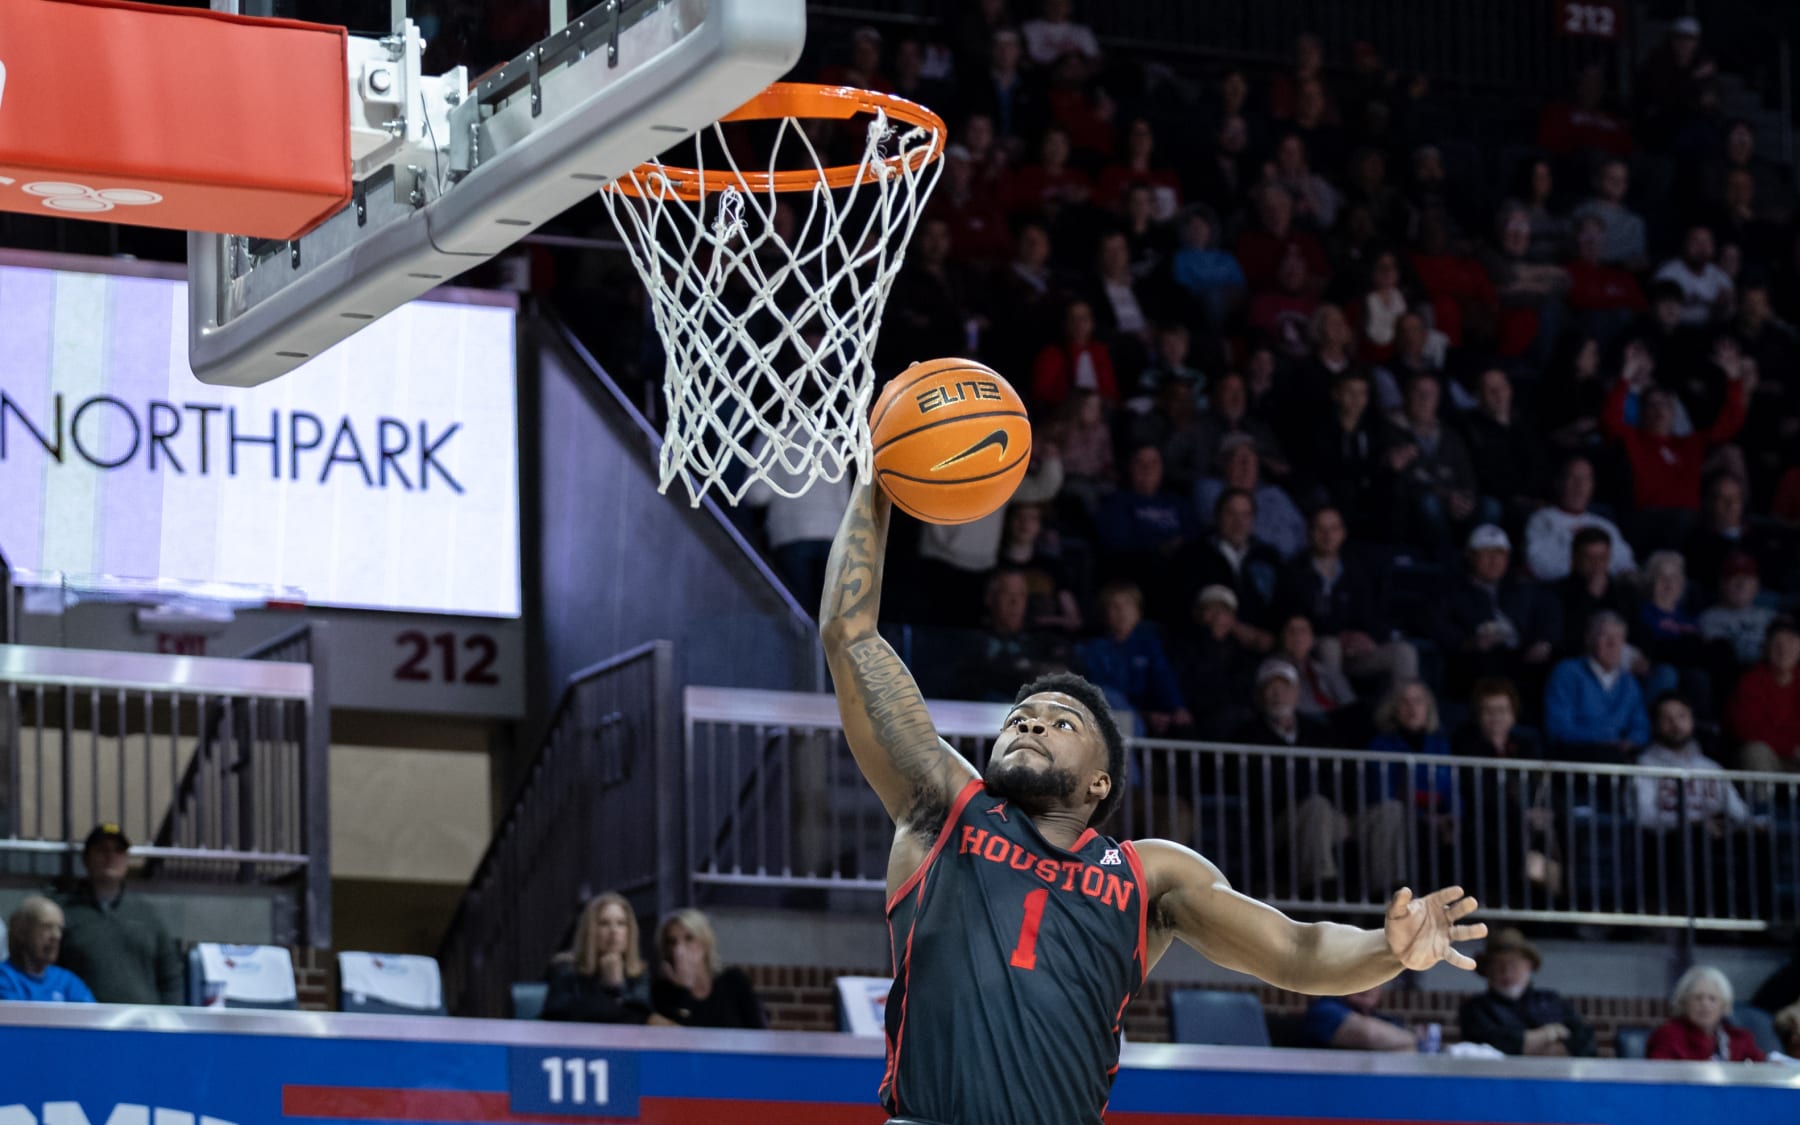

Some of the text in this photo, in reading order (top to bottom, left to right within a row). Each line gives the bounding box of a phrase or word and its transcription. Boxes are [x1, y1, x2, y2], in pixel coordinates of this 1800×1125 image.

[1565, 3, 1616, 34] 212
[916, 381, 1002, 414] ELITE
[0, 391, 466, 494] NORTHPARK
[395, 630, 499, 686] 212
[959, 824, 1134, 912] HOUSTON
[1009, 887, 1049, 971] 1
[542, 1057, 609, 1105] 111
